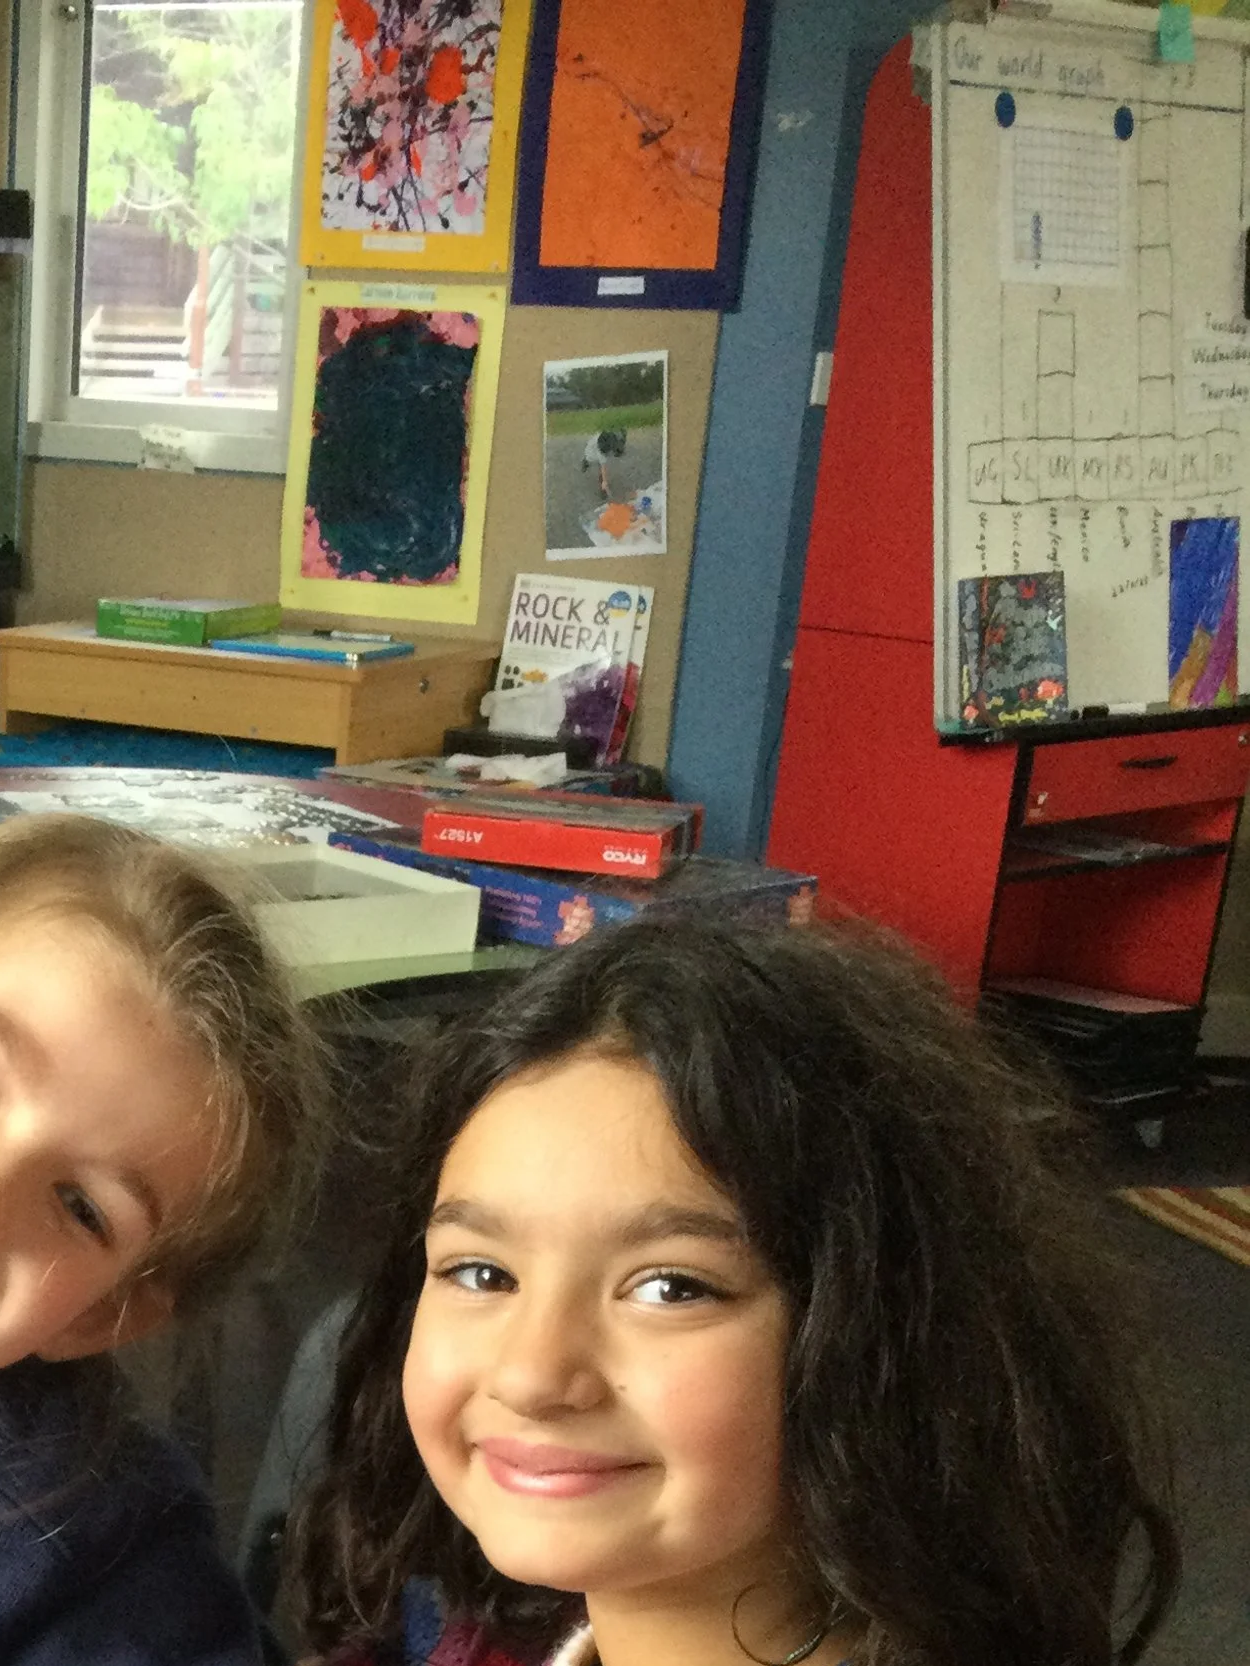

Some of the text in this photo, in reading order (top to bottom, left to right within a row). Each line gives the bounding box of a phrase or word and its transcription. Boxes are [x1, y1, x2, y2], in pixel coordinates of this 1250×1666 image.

[515, 592, 610, 625] ROCK &
[602, 851, 647, 866] RYCO
